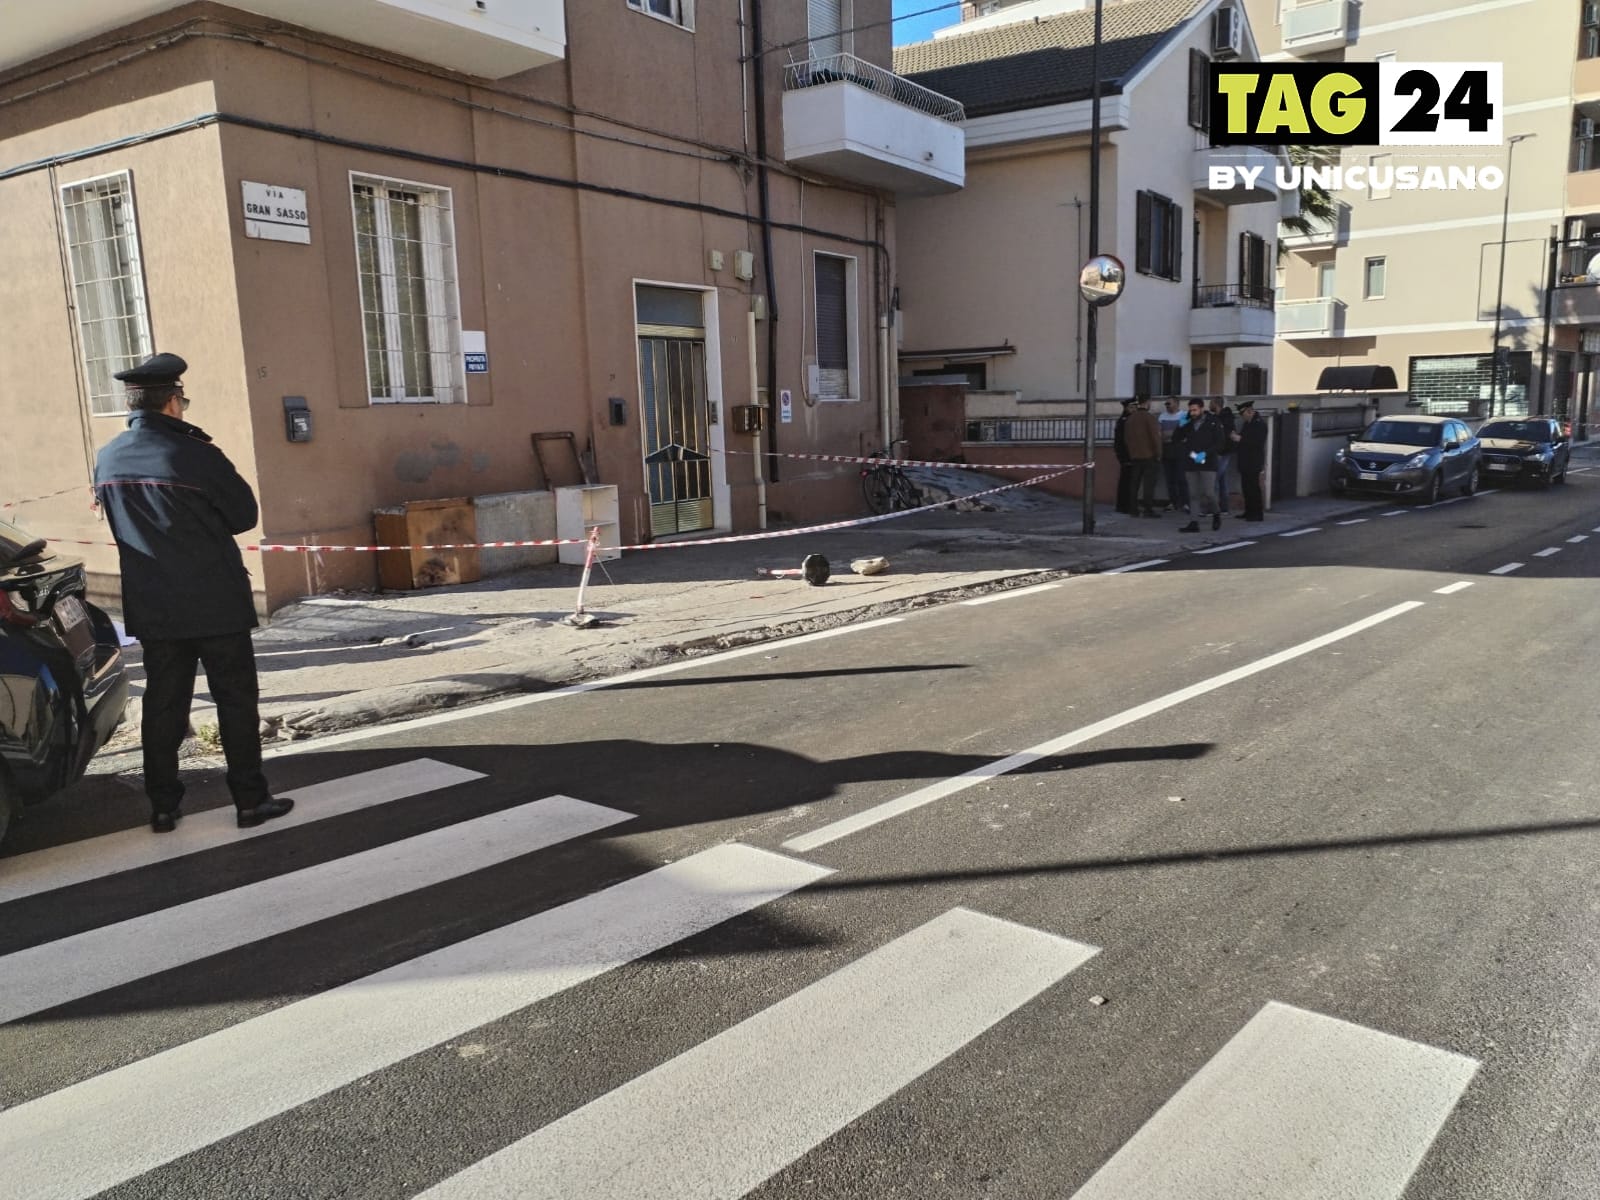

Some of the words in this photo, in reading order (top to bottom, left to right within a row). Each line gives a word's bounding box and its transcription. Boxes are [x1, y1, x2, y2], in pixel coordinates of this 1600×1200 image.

[265, 190, 284, 199] VIA
[246, 203, 271, 216] GRAN
[276, 207, 307, 221] SASSO
